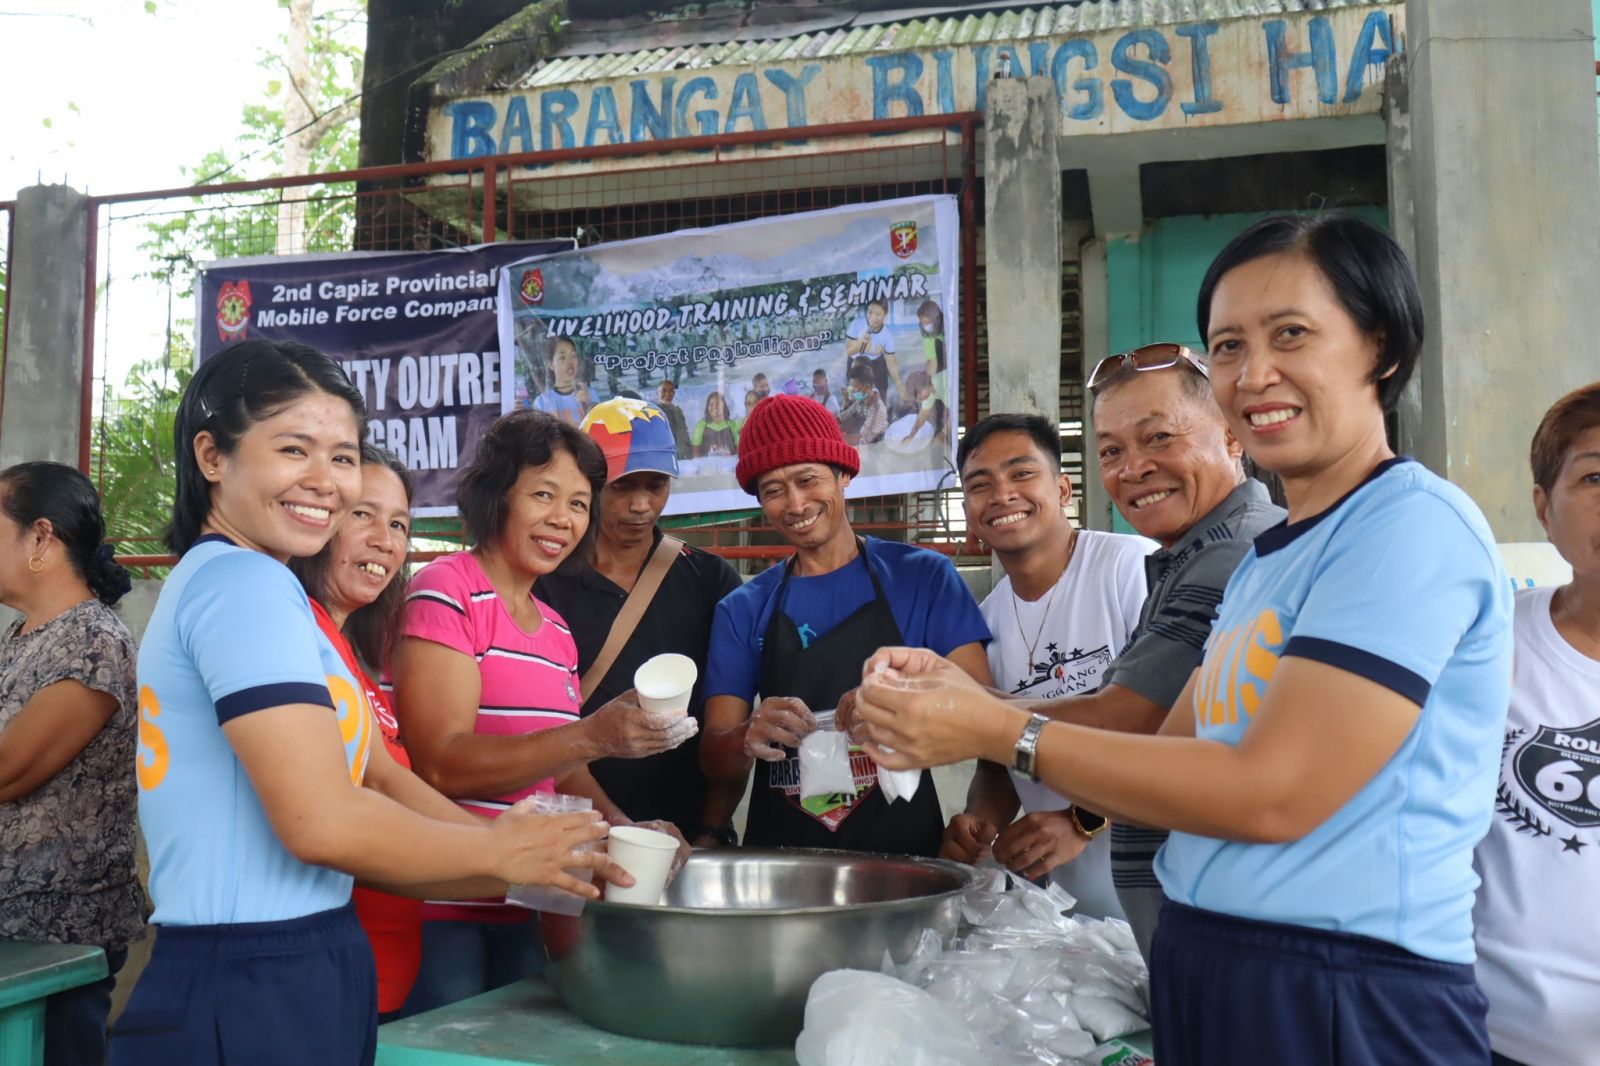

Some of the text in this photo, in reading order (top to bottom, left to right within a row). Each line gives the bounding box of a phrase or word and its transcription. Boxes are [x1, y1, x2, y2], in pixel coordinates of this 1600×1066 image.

[443, 64, 821, 174] BARANGAY
[272, 267, 497, 303] 2nd Capiz Provincial
[546, 308, 672, 339] LIVELIHOOD
[679, 291, 790, 328] TRAINING
[819, 273, 928, 311] SEMINAR
[257, 308, 329, 328] Mobile
[335, 305, 398, 323] Force
[341, 351, 500, 411] TY OUTRE
